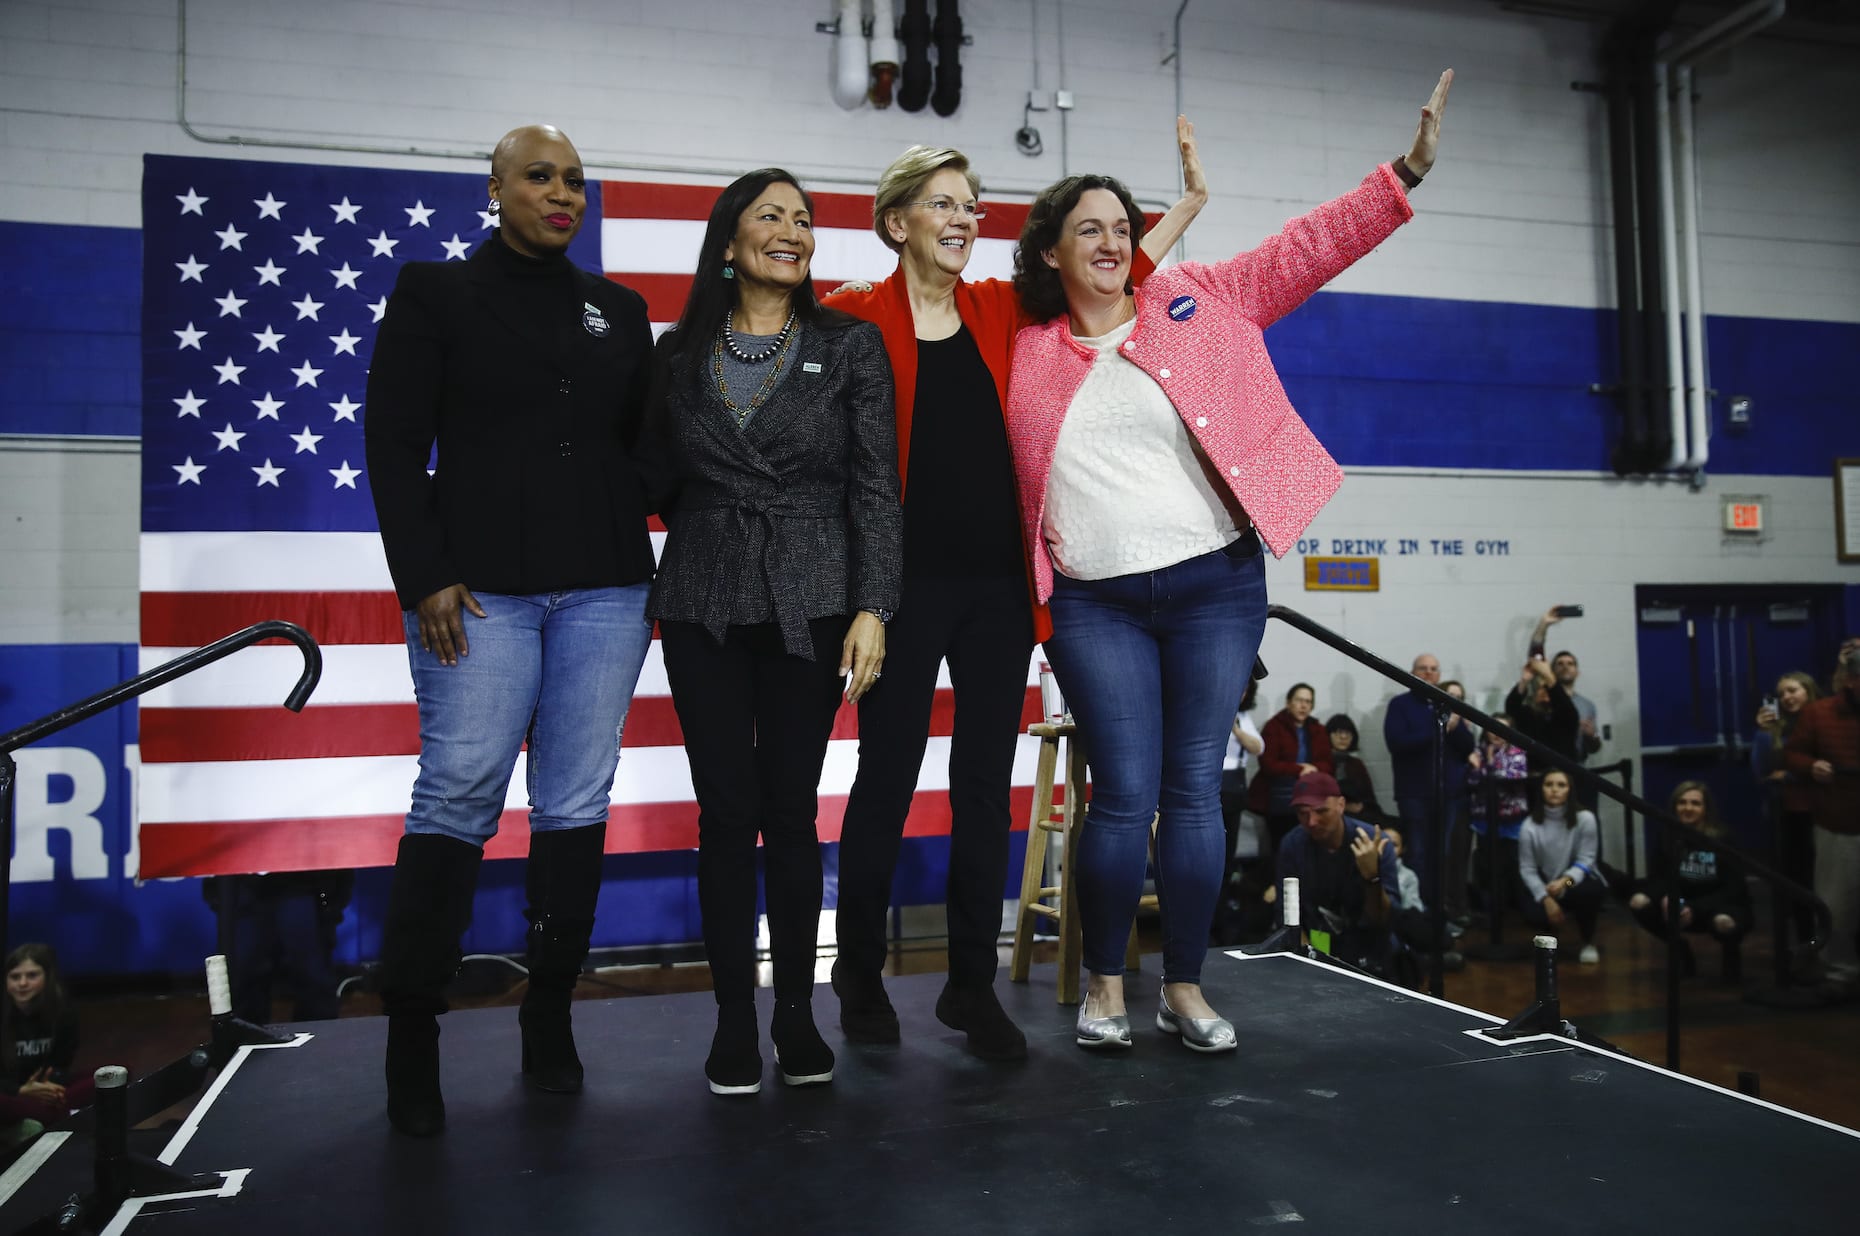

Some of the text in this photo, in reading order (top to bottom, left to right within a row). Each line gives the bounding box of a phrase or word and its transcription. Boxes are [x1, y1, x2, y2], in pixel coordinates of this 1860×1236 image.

[1170, 298, 1195, 316] WARREN
[1297, 539, 1509, 555] OR DRINK IN THE GYM
